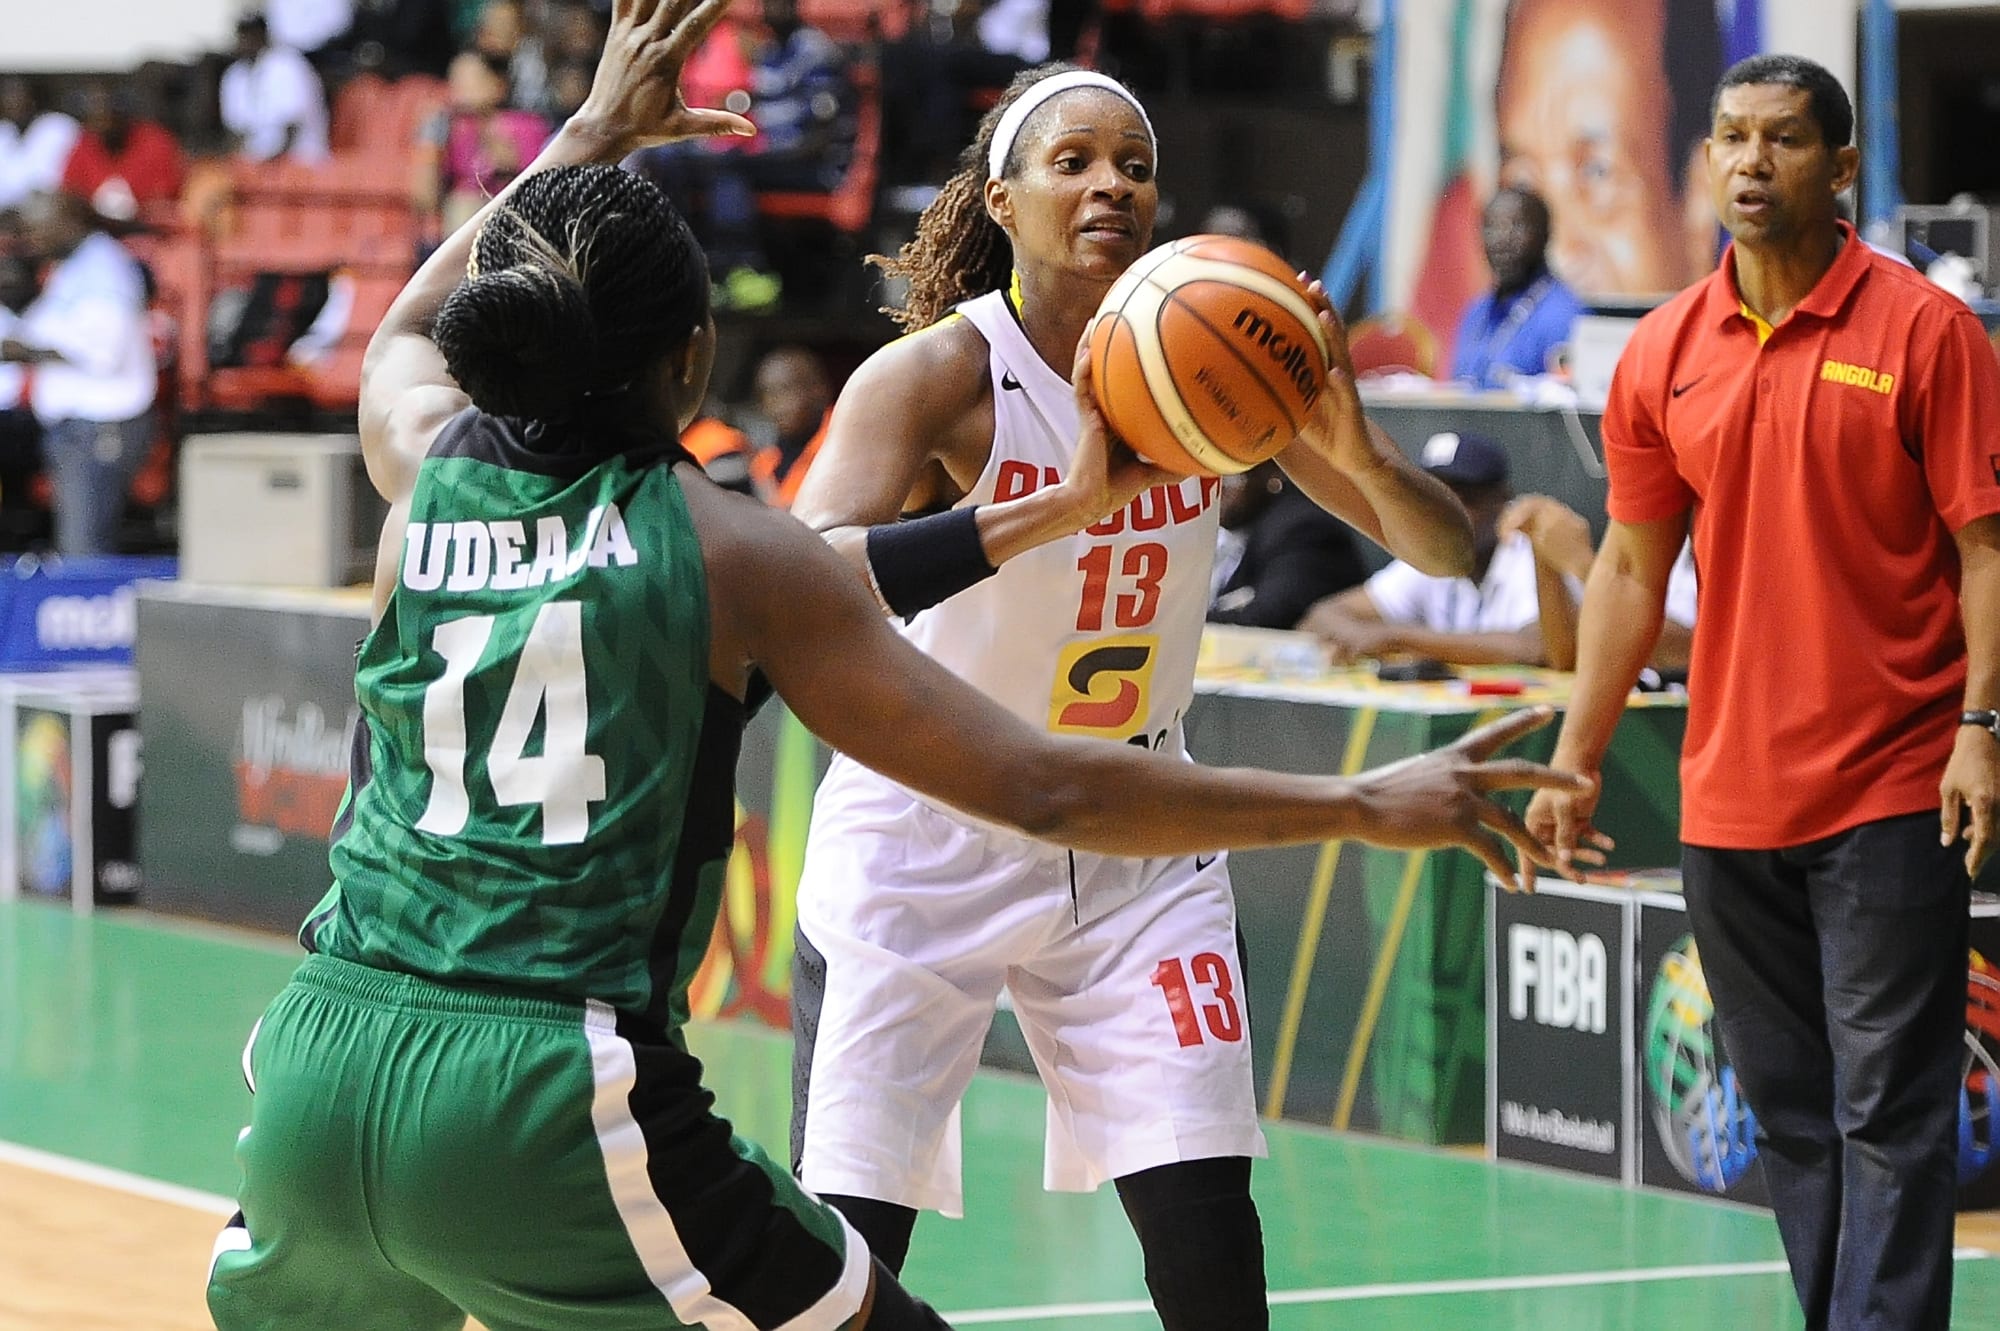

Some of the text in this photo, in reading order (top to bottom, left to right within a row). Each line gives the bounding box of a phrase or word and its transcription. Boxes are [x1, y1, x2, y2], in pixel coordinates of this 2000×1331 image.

[1820, 359, 1894, 395] ANGOLA
[403, 503, 639, 592] UDEAJA
[1076, 542, 1168, 631] 13
[415, 601, 606, 844] 14
[1150, 952, 1242, 1048] 13
[1508, 923, 1608, 1034] FIBA
